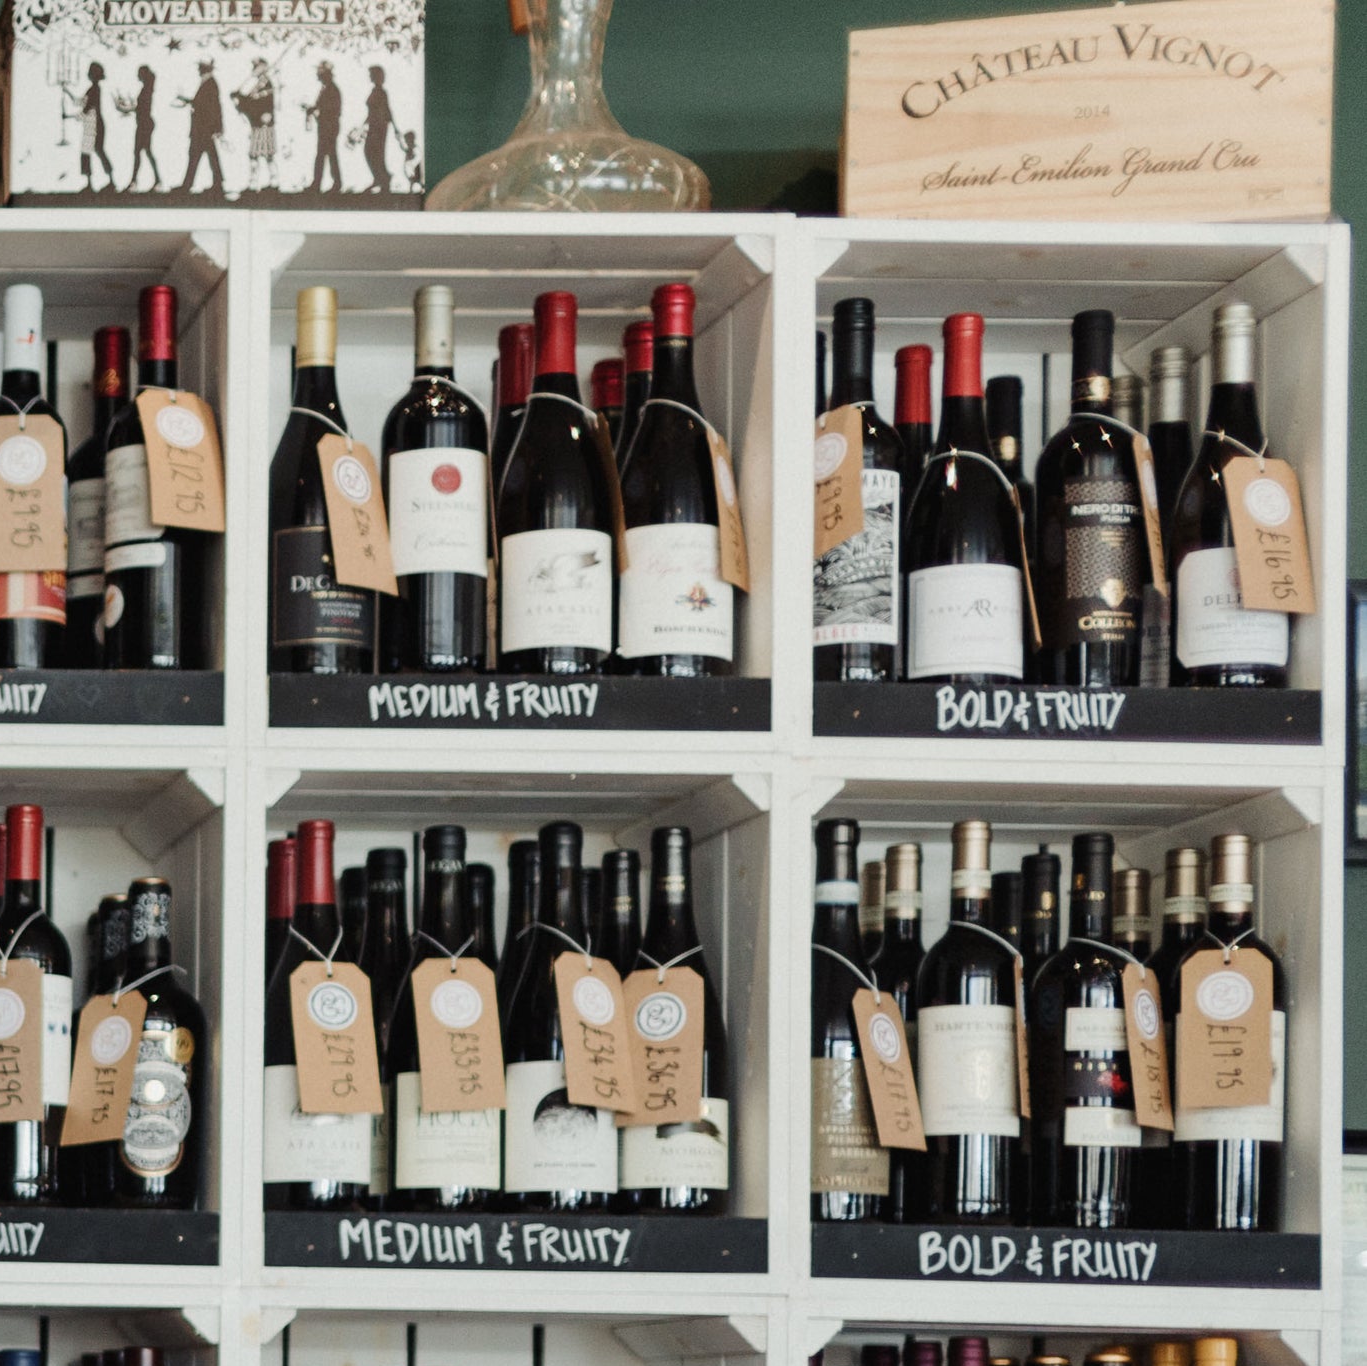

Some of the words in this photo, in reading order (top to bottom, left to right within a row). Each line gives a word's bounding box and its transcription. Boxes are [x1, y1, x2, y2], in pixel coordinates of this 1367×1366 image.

[107, 0, 251, 24] MOVEABLE
[267, 1, 342, 24] FEAST
[900, 34, 1099, 121] CHÂTEAU
[1113, 24, 1285, 94] VIGNOT
[1073, 104, 1111, 121] 2014
[921, 143, 1111, 194] Saint-Emilion
[1113, 141, 1213, 198] Grand
[1213, 139, 1261, 171] Cru
[369, 683, 480, 720] MEDIUM
[485, 682, 499, 720] &
[506, 681, 598, 717] FRUITY
[936, 685, 1013, 731] BOLD
[1011, 692, 1031, 730] &
[1035, 685, 1125, 730] FRUITY
[337, 1218, 483, 1270] MEDIUM
[497, 1223, 514, 1264] &
[523, 1223, 631, 1266] FRUITY
[915, 1231, 1016, 1282] BOLD
[1026, 1235, 1042, 1275] &
[1049, 1238, 1160, 1287] FRUITY
